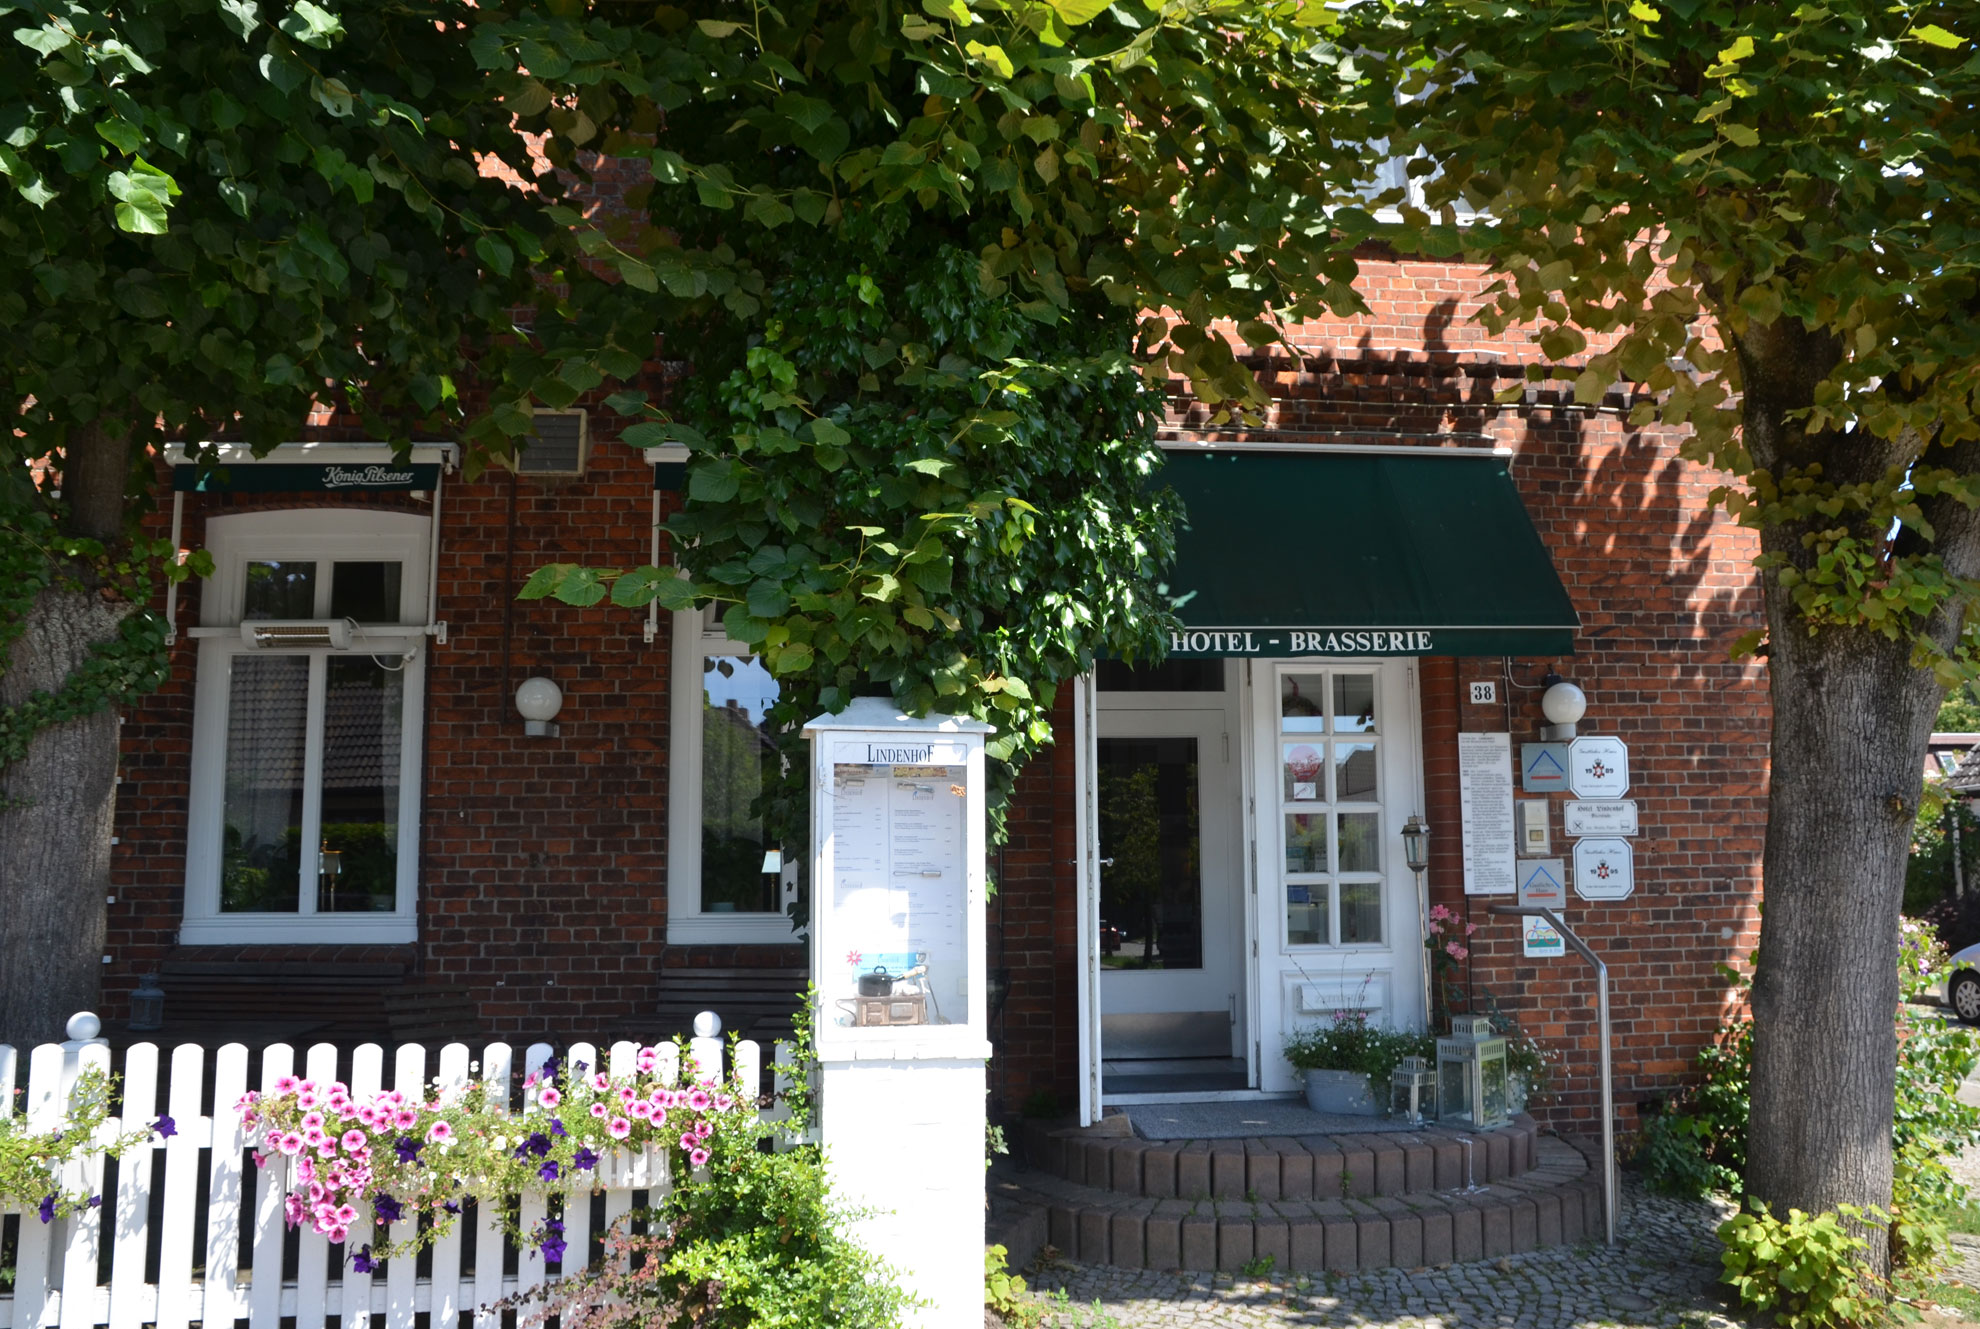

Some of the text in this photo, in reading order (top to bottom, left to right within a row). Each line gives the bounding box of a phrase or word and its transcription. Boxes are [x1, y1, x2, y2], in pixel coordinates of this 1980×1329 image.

[322, 465, 414, 486] König Pilsener
[1171, 632, 1260, 651] HOTEL
[1290, 631, 1433, 651] BRASSERIE
[1475, 685, 1491, 700] 38
[867, 744, 934, 762] LINDENHOF
